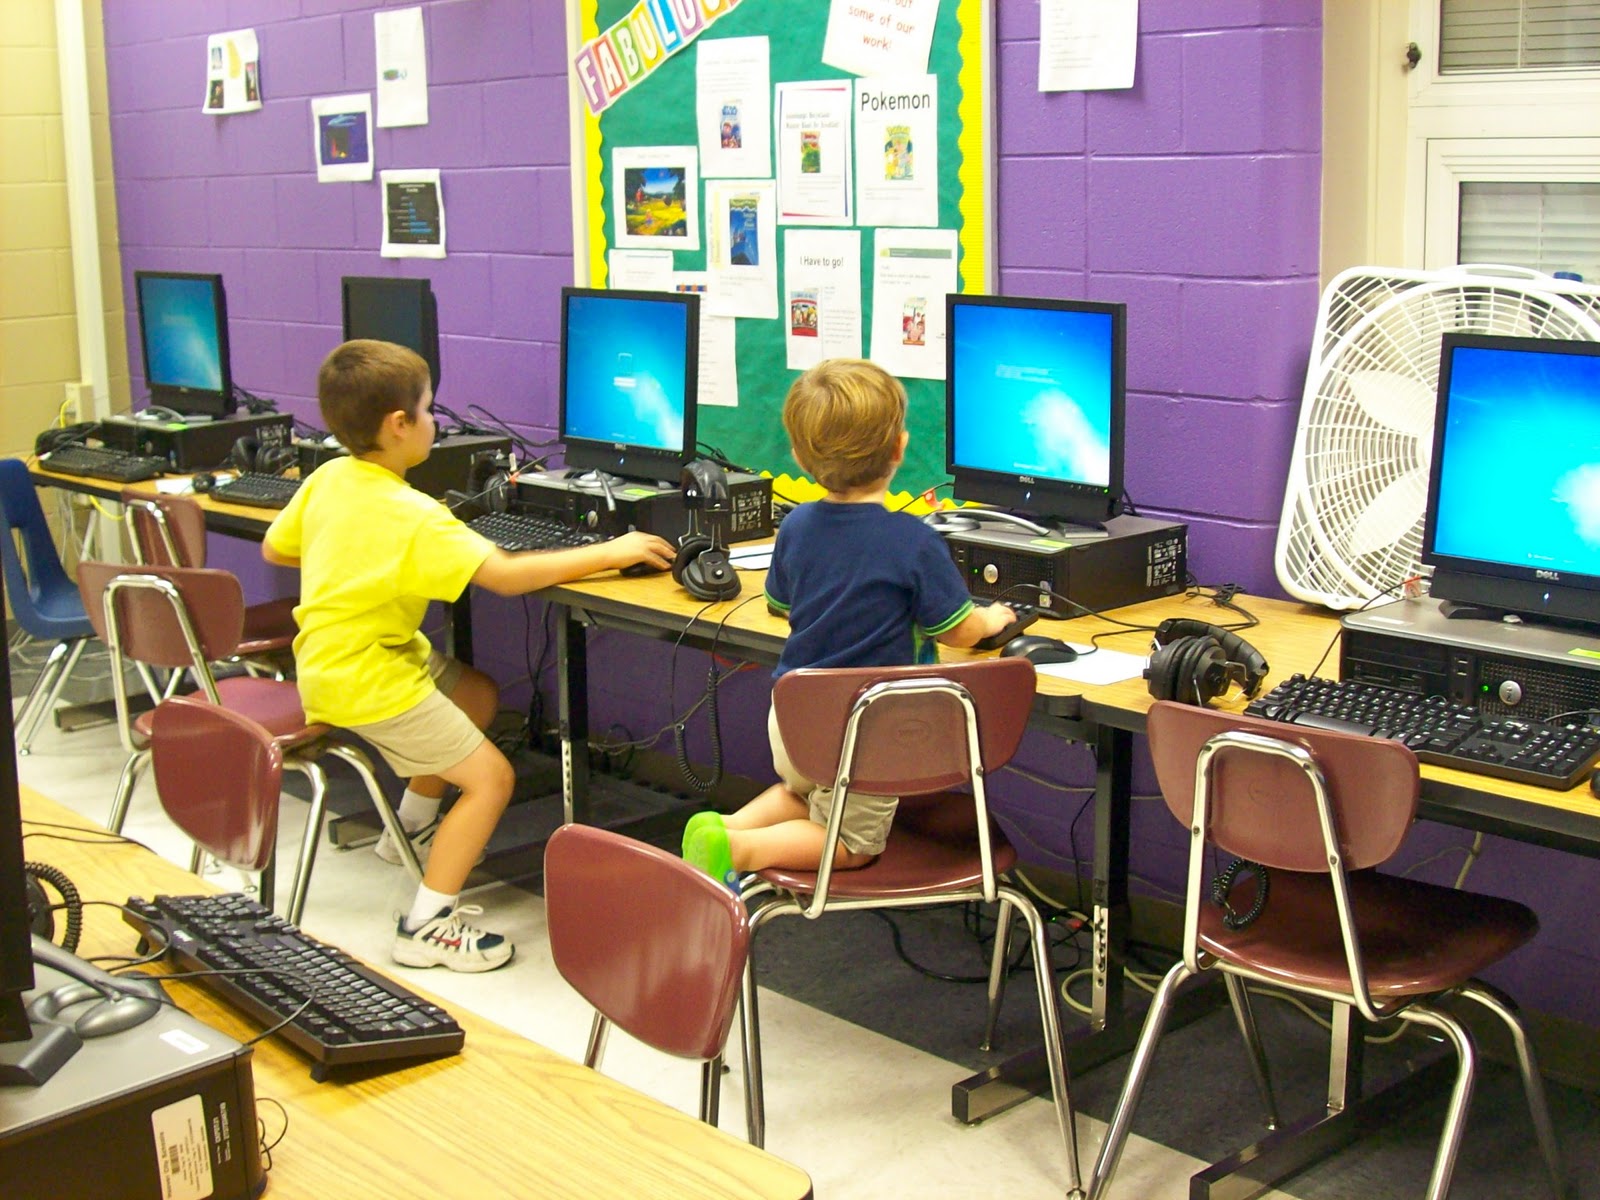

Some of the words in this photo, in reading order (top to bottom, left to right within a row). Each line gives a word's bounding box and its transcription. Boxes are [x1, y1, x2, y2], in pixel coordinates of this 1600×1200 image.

[848, 5, 875, 22] some
[880, 14, 892, 28] of
[896, 22, 915, 35] our
[863, 34, 892, 51] work!
[861, 91, 931, 111] Pokemon
[804, 256, 821, 266] Have
[822, 257, 830, 266] to
[832, 257, 844, 268] go!
[1019, 475, 1035, 485] DELL
[1535, 569, 1560, 581] DELL
